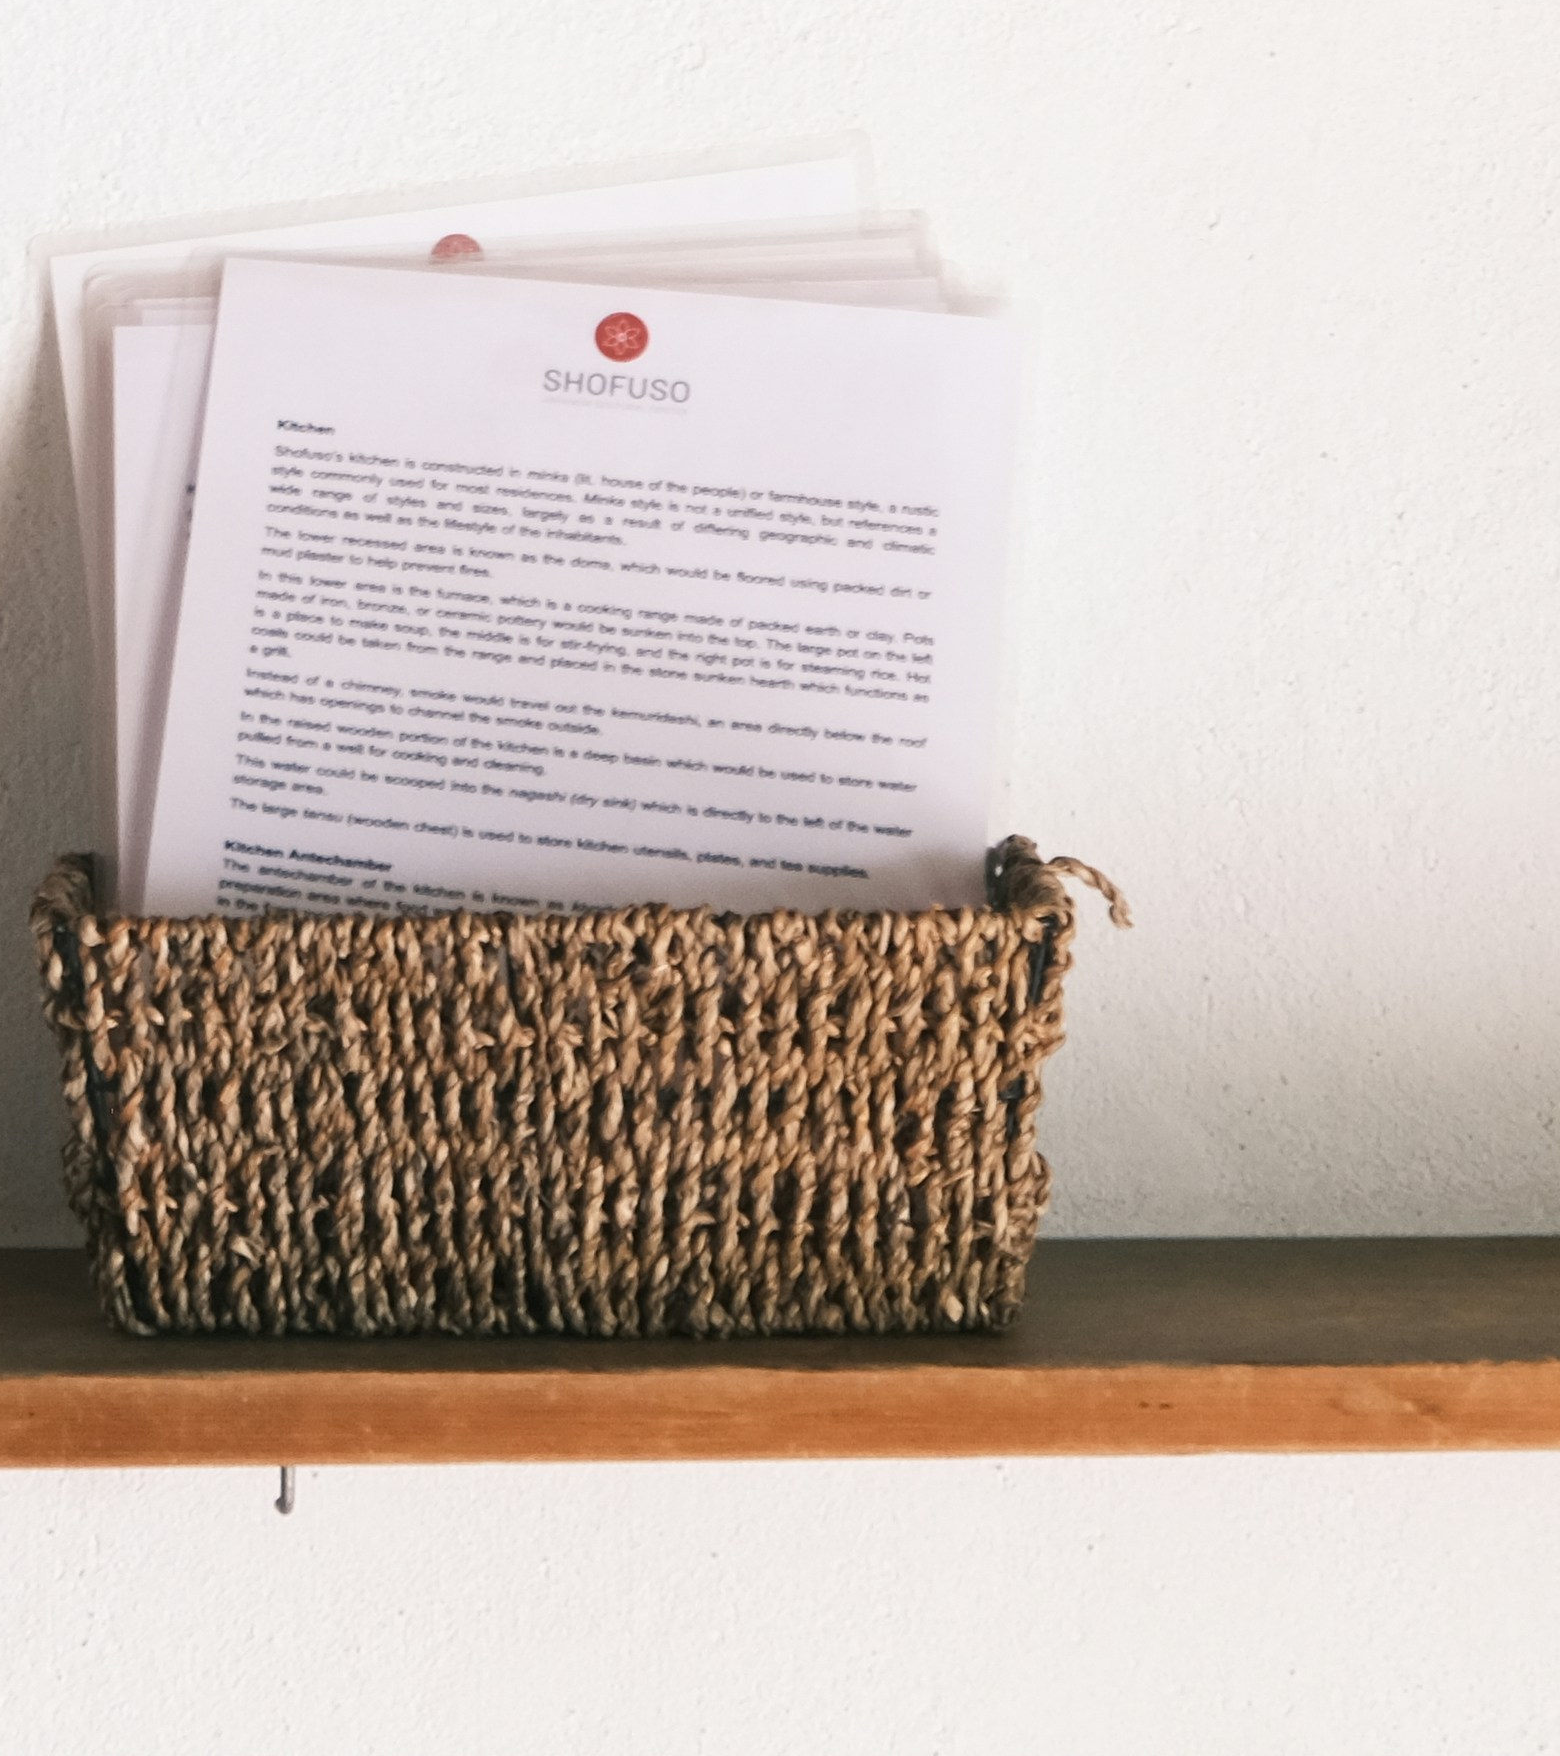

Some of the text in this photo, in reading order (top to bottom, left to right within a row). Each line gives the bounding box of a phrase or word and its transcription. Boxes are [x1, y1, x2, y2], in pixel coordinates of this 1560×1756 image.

[542, 368, 691, 404] SHOFUSO
[276, 419, 335, 435] Kitchen
[266, 503, 339, 519] conditions
[270, 465, 304, 479] style
[309, 470, 383, 487] commonly
[582, 492, 626, 507] Minka
[629, 498, 663, 512] style
[726, 507, 774, 521] unified
[847, 518, 923, 535] references
[348, 452, 400, 467] kitchen
[420, 461, 504, 477] constructed
[526, 470, 570, 483] minka
[600, 474, 644, 490] house
[691, 485, 747, 500] people)
[767, 490, 843, 508] farmhouse
[900, 505, 939, 518] rustic
[311, 488, 353, 503] range
[385, 495, 427, 508] styles
[521, 506, 569, 523] largely
[621, 517, 662, 529] result
[692, 522, 750, 541] differing
[758, 530, 837, 546] geographic
[881, 540, 935, 555] climatic
[295, 549, 345, 563] plaster
[400, 560, 456, 574] prevent
[297, 529, 336, 544] lower
[341, 536, 407, 551] recessed
[468, 546, 515, 560] known
[619, 561, 661, 574] which
[664, 566, 709, 579] would
[735, 570, 785, 587] floored
[789, 577, 829, 593] using
[832, 582, 885, 596] packed
[308, 575, 347, 589] lower
[498, 595, 541, 608] which
[576, 603, 633, 620] cooking
[637, 609, 679, 624] range
[747, 620, 800, 633] packed
[285, 610, 325, 625] place
[465, 630, 514, 644] middle
[694, 651, 727, 667] right
[800, 662, 866, 681] steaming
[434, 608, 491, 623] ceramic
[495, 614, 547, 630] pottery
[551, 620, 594, 633] would
[620, 626, 673, 640] sunken
[795, 641, 832, 658] large
[250, 626, 289, 639] coals
[293, 631, 334, 644] could
[360, 637, 401, 651] taken
[471, 650, 512, 664] range
[549, 656, 598, 671] placed
[648, 667, 688, 680] stone
[692, 671, 745, 685] sunken
[798, 681, 840, 694] which
[843, 684, 908, 701] functions
[243, 686, 285, 700] which
[319, 697, 386, 714] openings
[407, 705, 465, 721] channel
[494, 716, 543, 729] smoke
[245, 667, 299, 684] Instead
[408, 688, 457, 702] smoke
[461, 693, 505, 706] would
[508, 697, 550, 711] travel
[767, 722, 819, 740] directly
[823, 728, 866, 742] below
[236, 730, 282, 745] pulled
[391, 749, 448, 767] cooking
[286, 718, 332, 732] raised
[335, 724, 394, 739] wooden
[398, 731, 449, 745] portion
[496, 739, 549, 755] kitchen
[665, 758, 708, 771] which
[711, 764, 755, 777] would
[837, 775, 874, 789] store
[876, 780, 917, 793] water
[232, 774, 287, 792] storage
[270, 760, 310, 774] water
[314, 766, 356, 780] could
[639, 800, 682, 814] which
[701, 806, 755, 824] directly
[872, 825, 913, 838] water
[260, 801, 298, 819] large
[346, 813, 409, 830] (wooden
[413, 821, 459, 836] chest)
[535, 834, 573, 848] store
[575, 837, 628, 854] kitchen
[223, 839, 392, 872] Kitchen Antechamber
